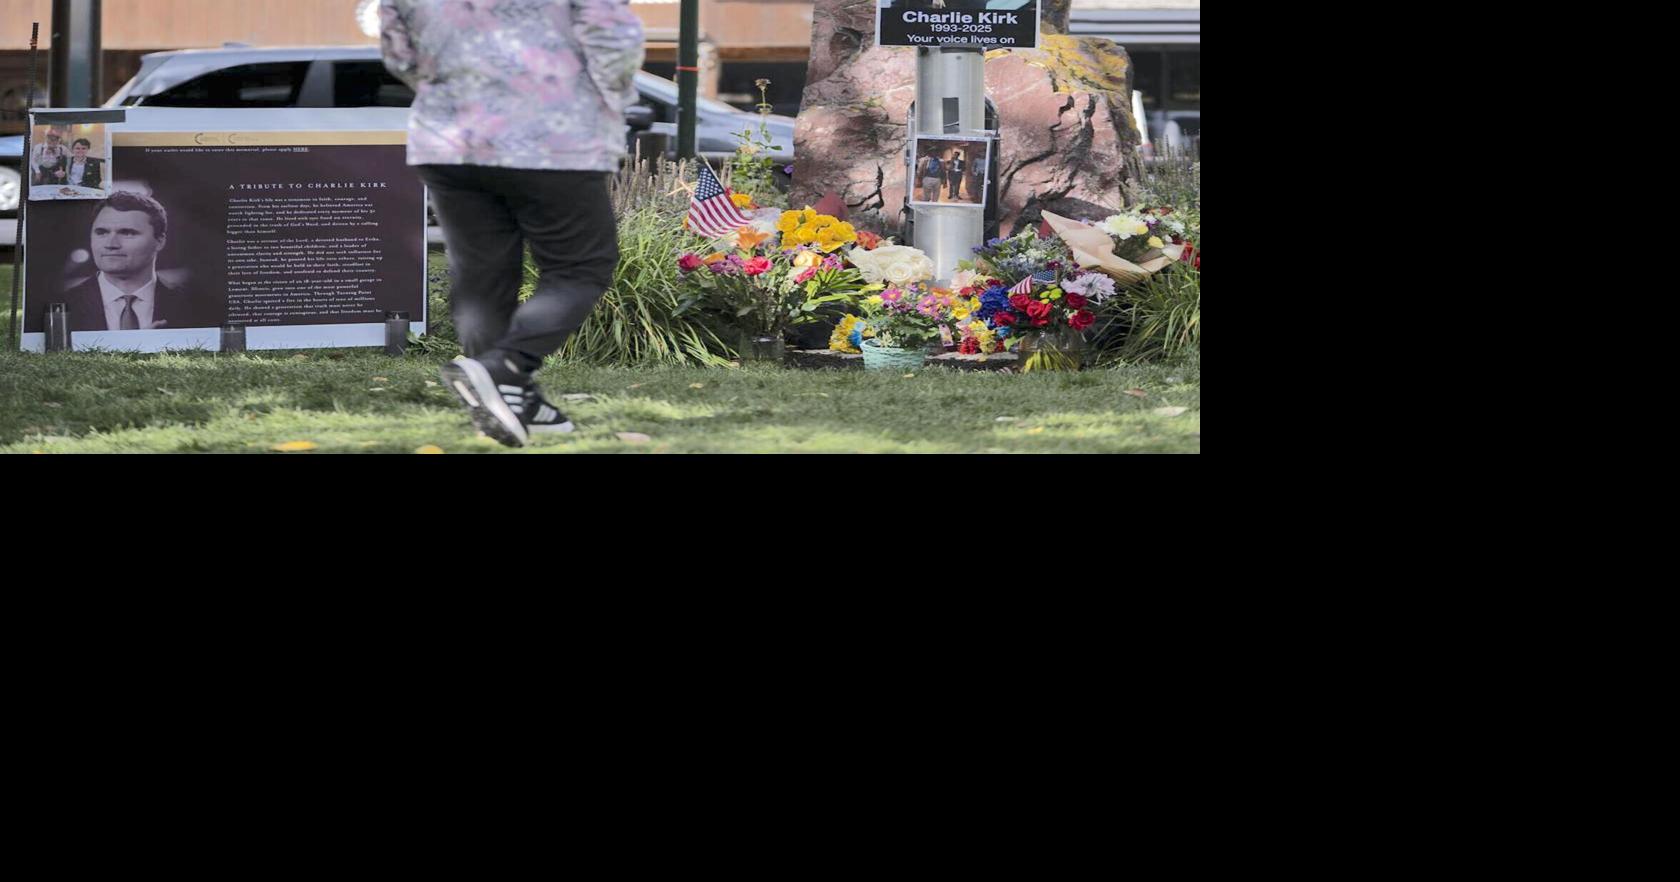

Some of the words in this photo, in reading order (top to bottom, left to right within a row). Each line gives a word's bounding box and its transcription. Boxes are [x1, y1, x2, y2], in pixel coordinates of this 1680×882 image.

[902, 11, 973, 24] Charlie
[978, 12, 1018, 25] Kirk
[930, 24, 992, 33] 1993-2025
[906, 34, 934, 43] Your
[937, 34, 968, 43] voice
[970, 35, 997, 44] lives
[1000, 36, 1015, 44] on
